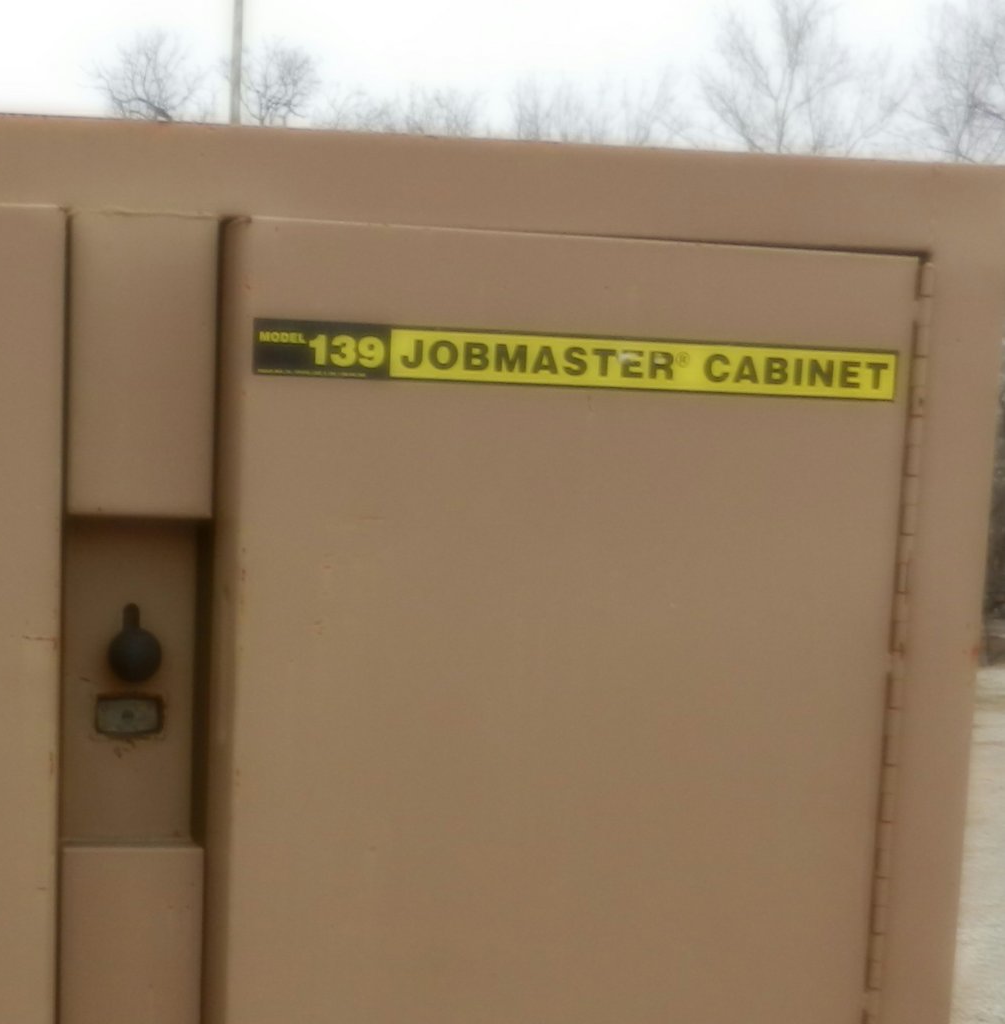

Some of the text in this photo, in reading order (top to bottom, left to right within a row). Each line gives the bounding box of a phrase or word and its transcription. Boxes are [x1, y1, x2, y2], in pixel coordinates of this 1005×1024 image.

[258, 330, 386, 369] MODEL 139
[703, 353, 889, 390] CABINET
